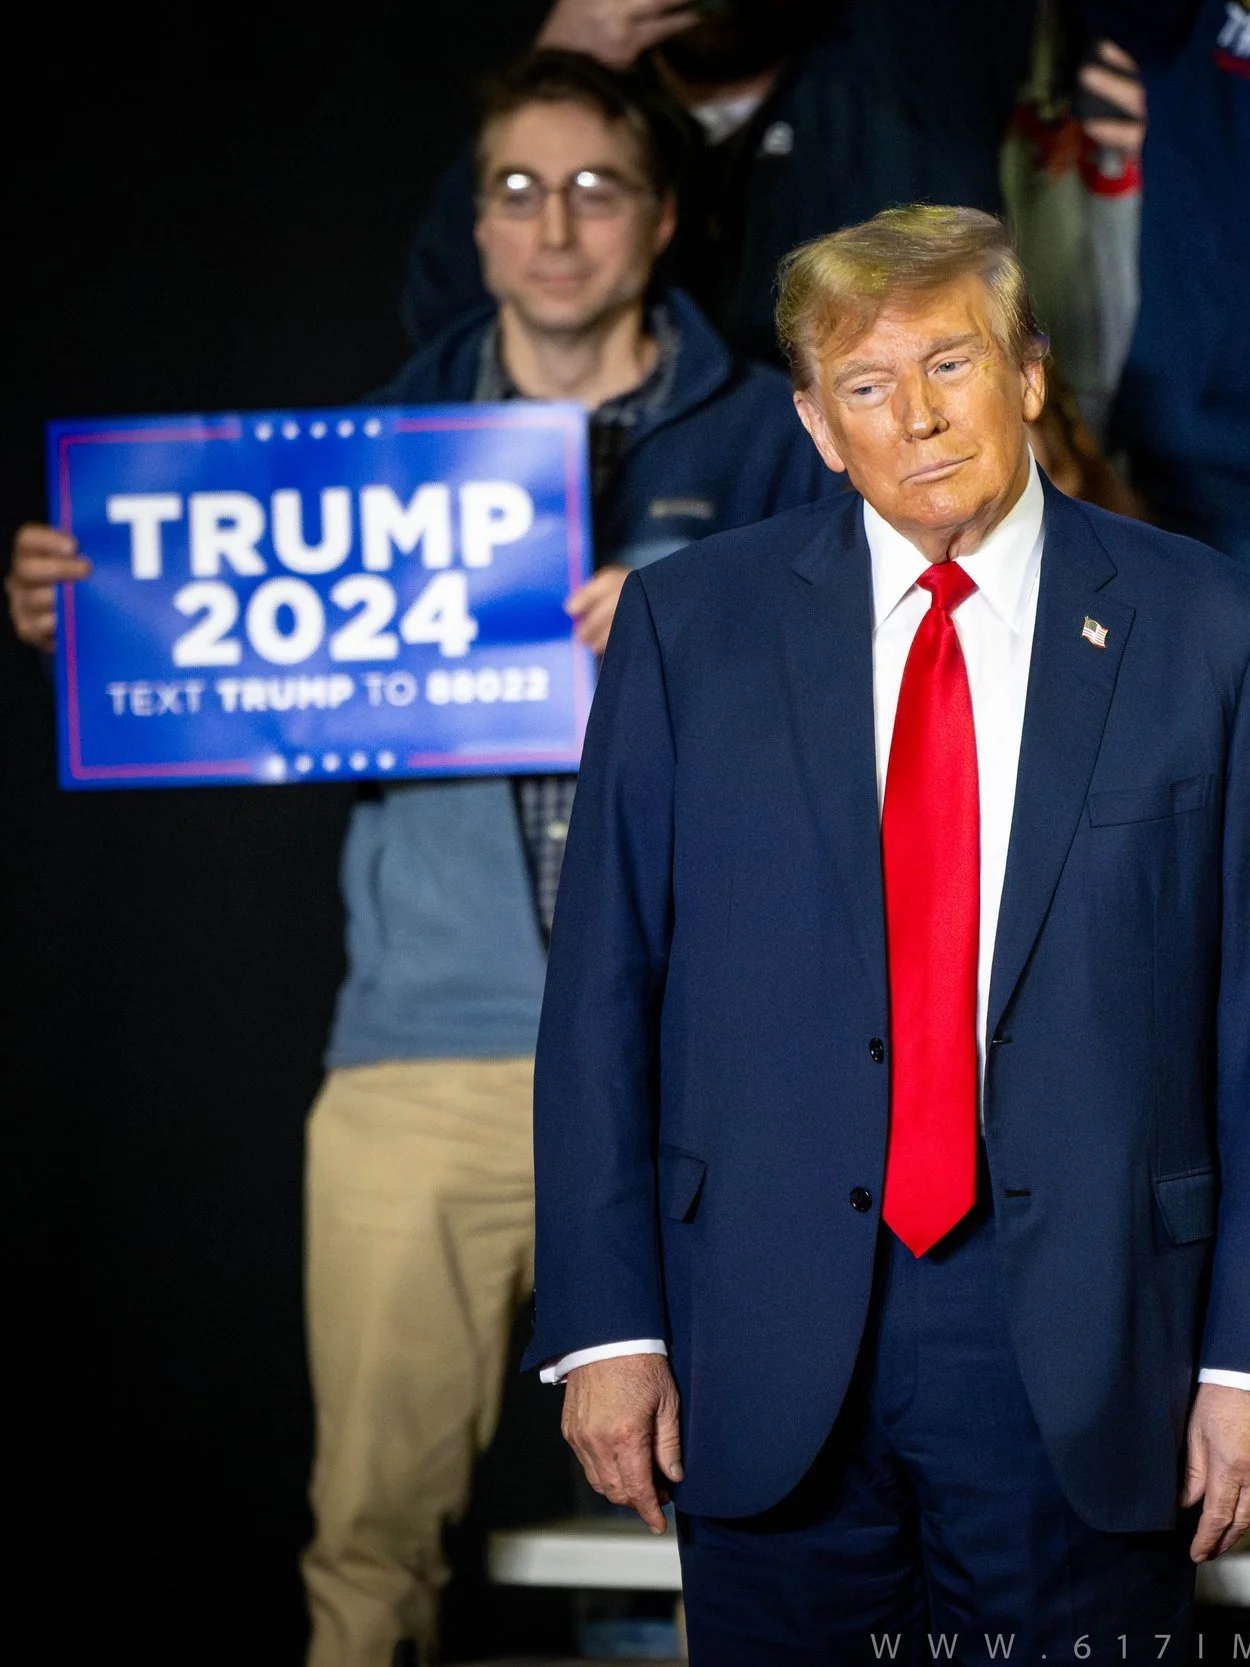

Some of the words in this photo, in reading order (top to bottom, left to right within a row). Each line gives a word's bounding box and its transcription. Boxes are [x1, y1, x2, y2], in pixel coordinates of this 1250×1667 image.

[107, 481, 535, 579] TRUMP
[172, 570, 479, 668] 2024
[107, 681, 204, 716] TEXT
[215, 673, 354, 713] TRUMP
[364, 671, 417, 707] TO
[426, 666, 550, 705] 88022
